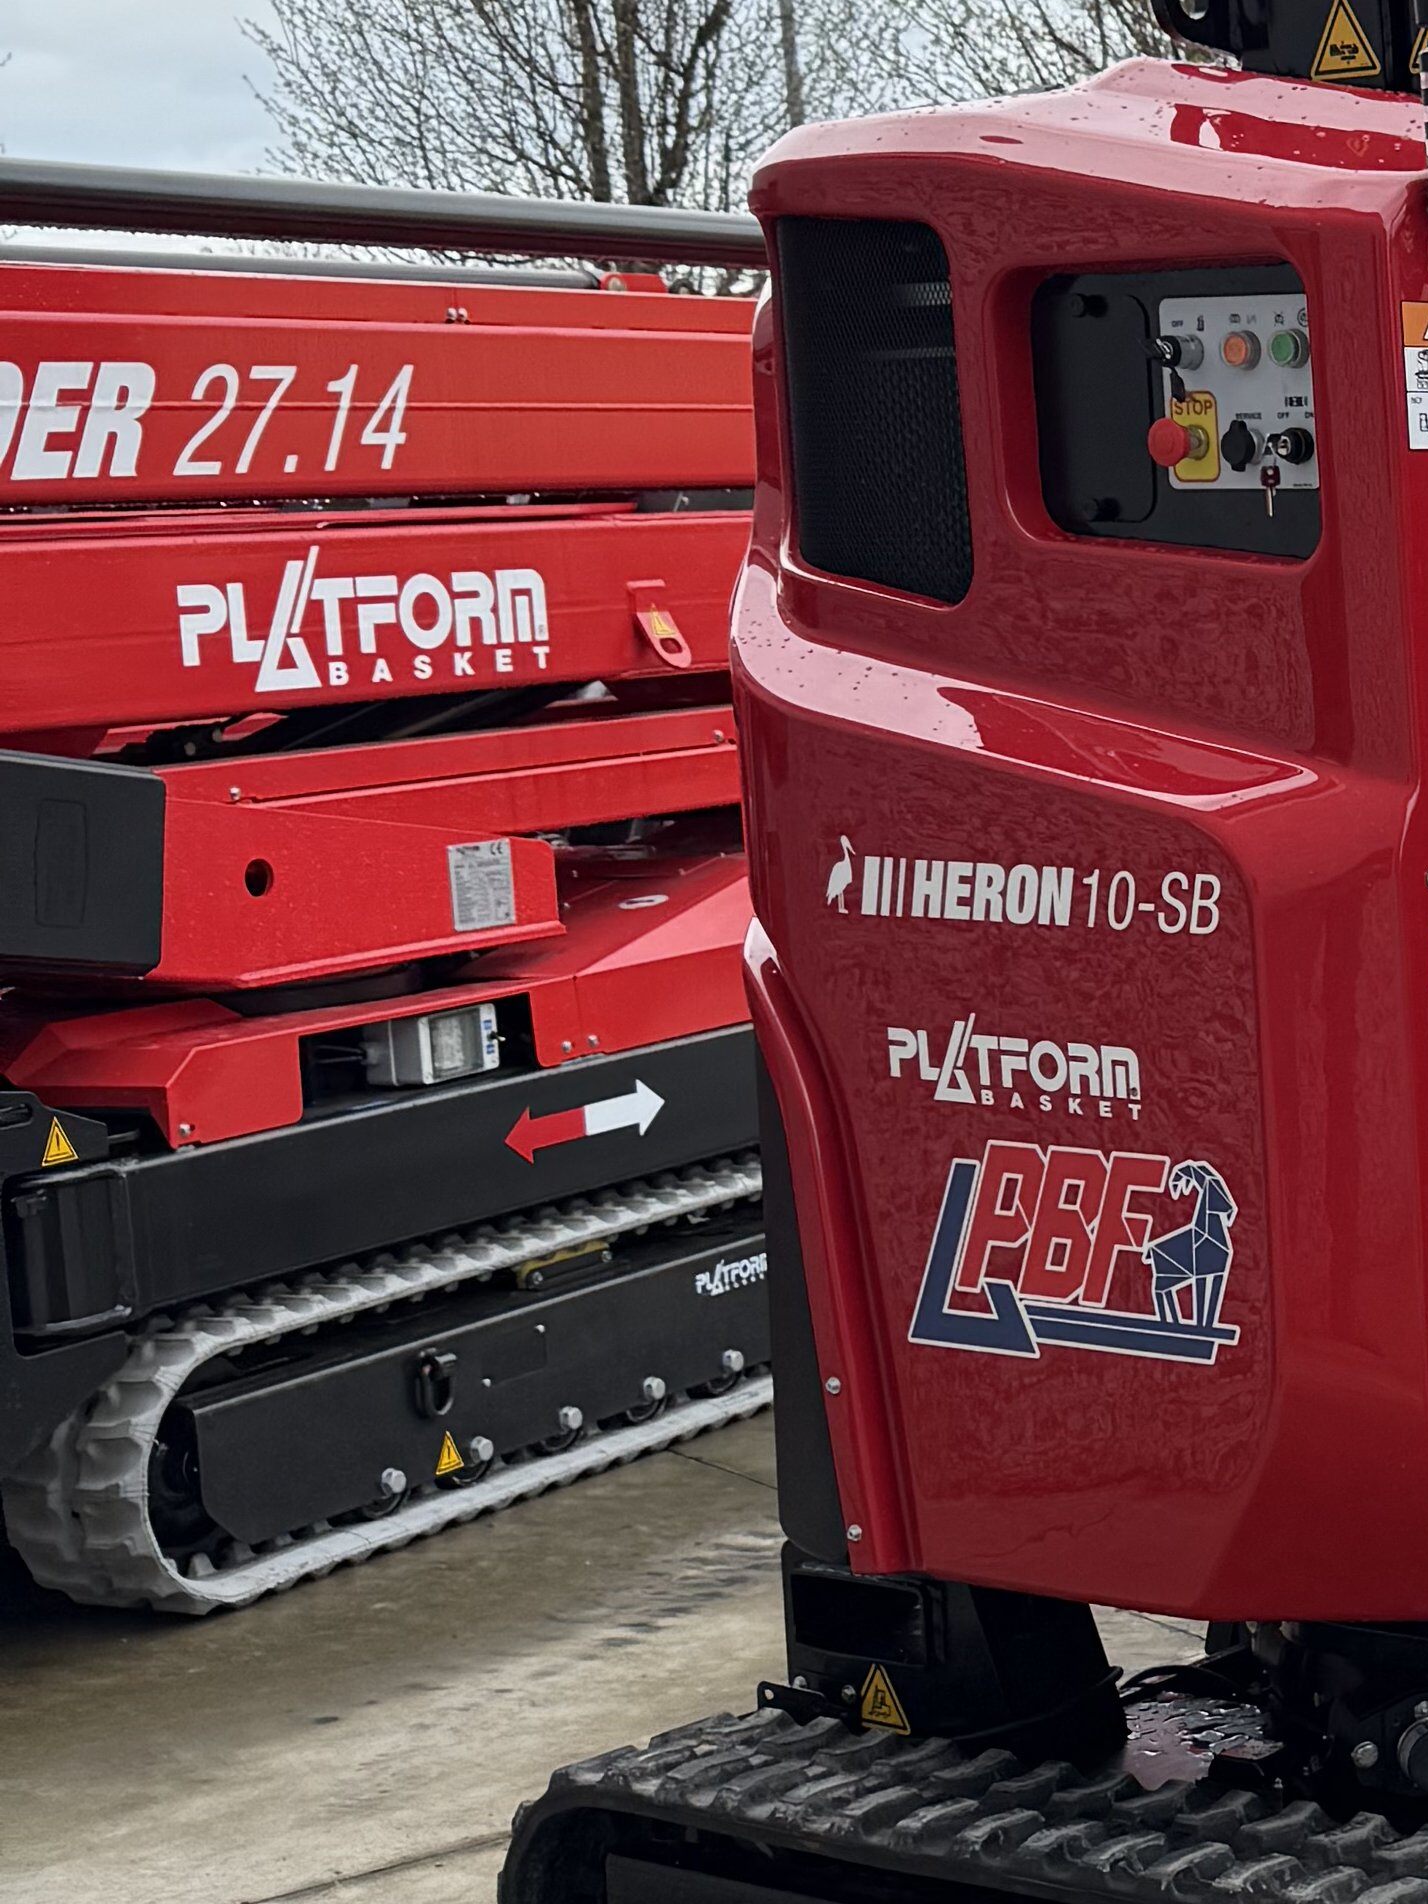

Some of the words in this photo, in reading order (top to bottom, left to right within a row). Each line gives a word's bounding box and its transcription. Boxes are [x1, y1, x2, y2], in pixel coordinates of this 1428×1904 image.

[172, 363, 414, 477] 27.14
[1174, 398, 1213, 416] STOP
[176, 545, 550, 693] PLATFORM
[328, 645, 550, 687] BASKET
[910, 858, 1075, 927] HERON
[1082, 868, 1221, 935] 10-SB
[887, 1012, 1141, 1105] PLATFORM
[980, 1089, 1142, 1121] BASKET
